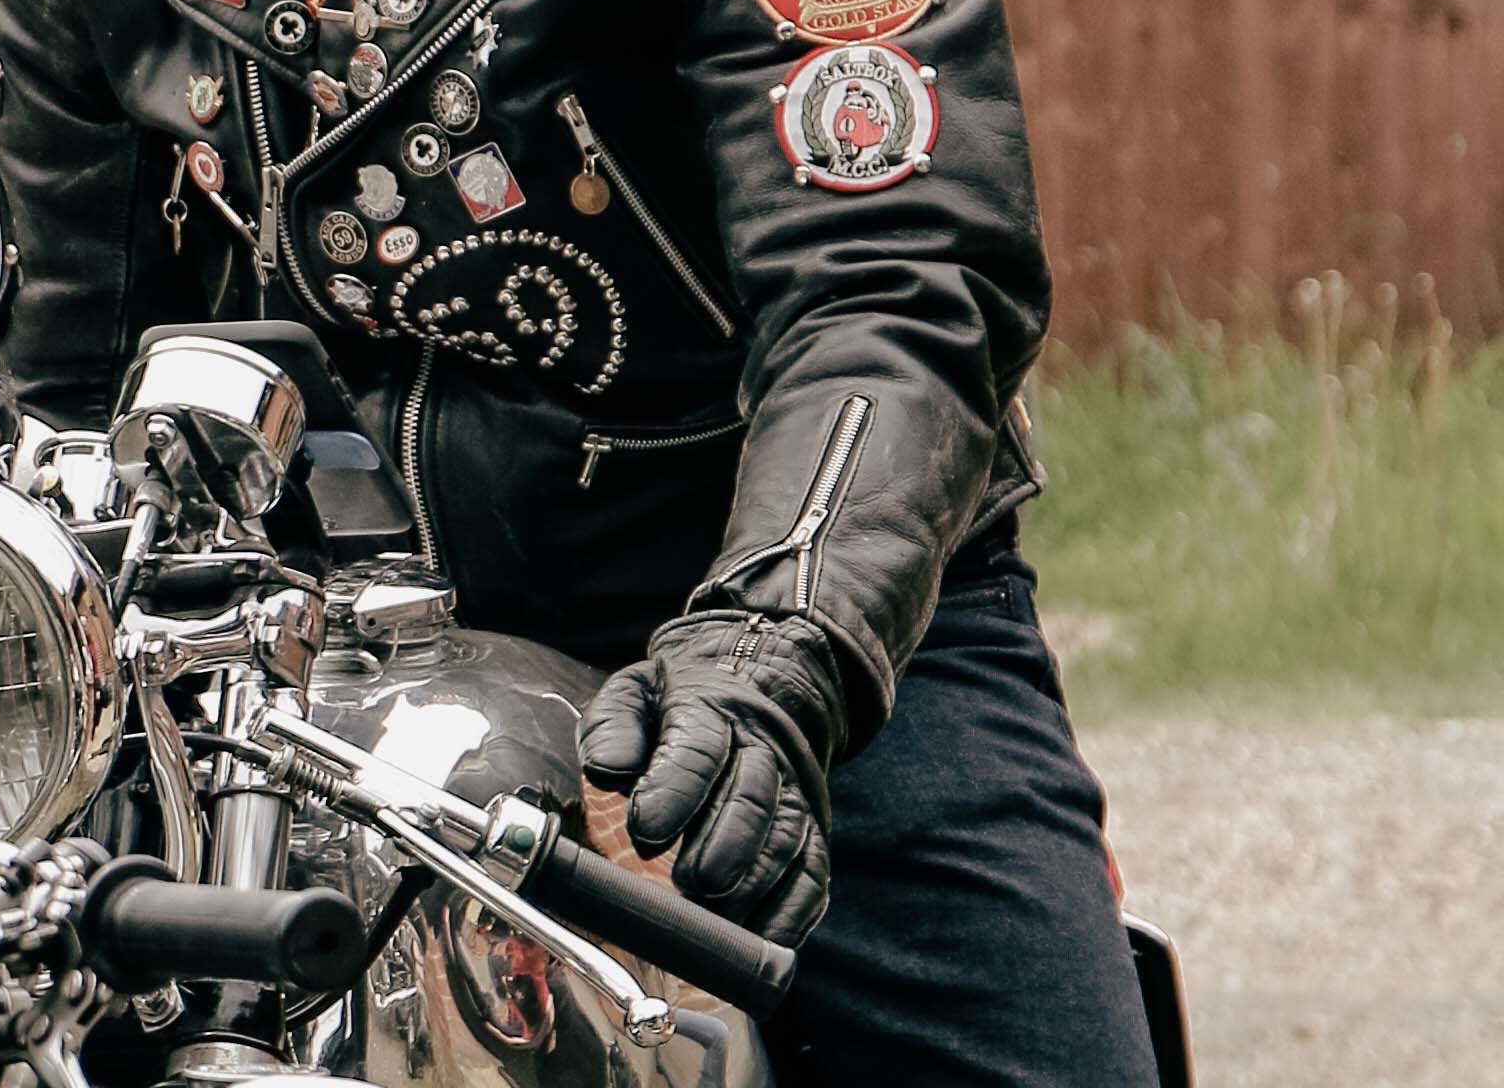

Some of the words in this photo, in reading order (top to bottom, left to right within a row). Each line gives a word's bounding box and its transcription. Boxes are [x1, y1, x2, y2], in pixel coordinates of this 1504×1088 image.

[813, 11, 867, 28] GOLD
[819, 62, 900, 87] SALTBOX
[322, 220, 333, 240] ACE
[332, 214, 356, 228] CAFE
[334, 229, 353, 248] 59
[332, 239, 365, 262] LONDON
